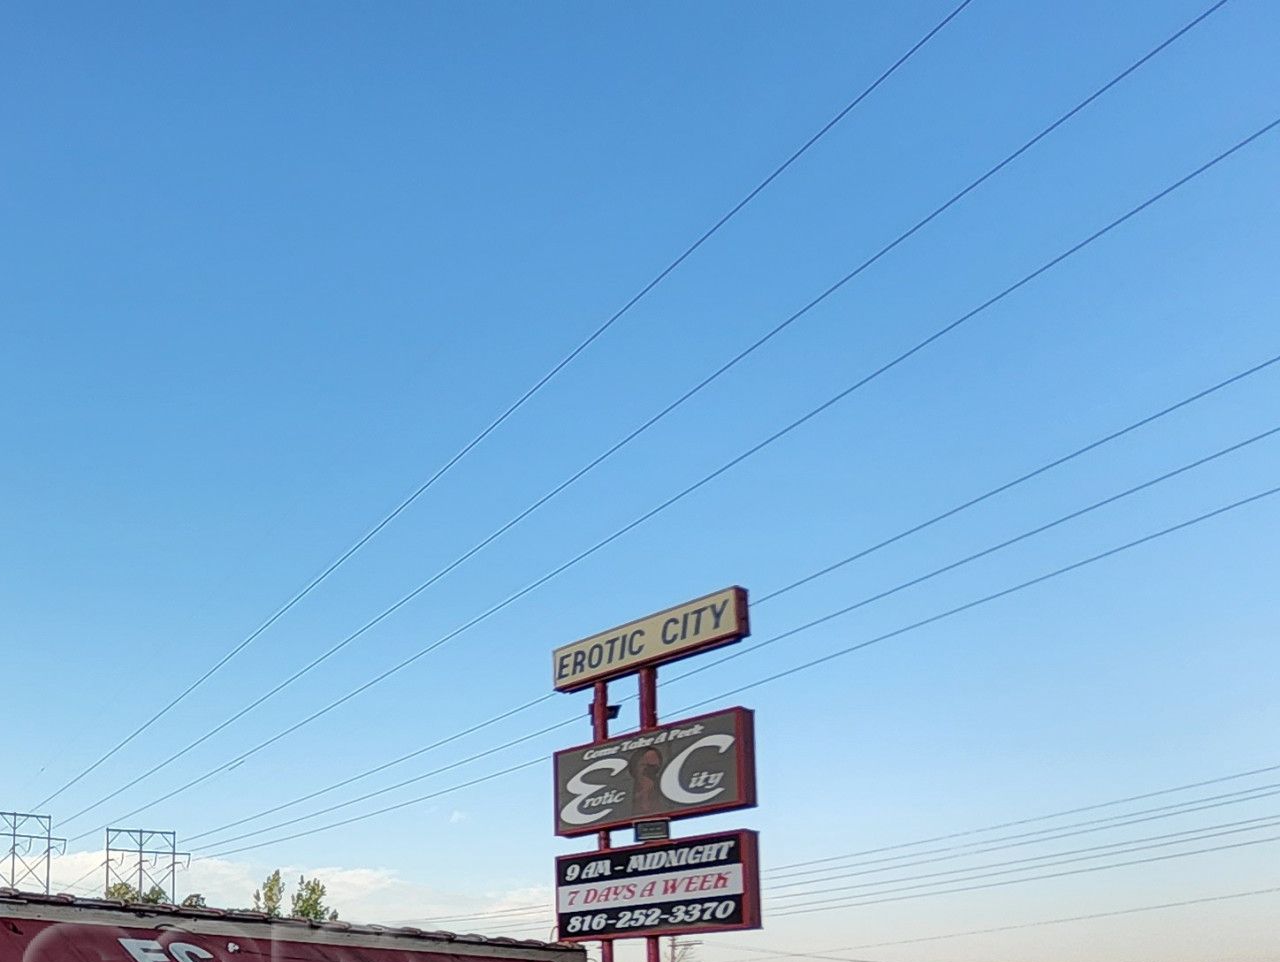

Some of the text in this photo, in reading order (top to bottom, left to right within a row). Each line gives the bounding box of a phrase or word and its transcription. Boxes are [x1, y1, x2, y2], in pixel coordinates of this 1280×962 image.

[558, 598, 730, 680] EROTIC CITY
[565, 864, 580, 882] 9
[581, 859, 612, 880] AM
[626, 841, 735, 873] MIDNIGHT
[568, 871, 732, 906] 7 DAYS A WEEK
[566, 900, 736, 933] 816-252-3370
